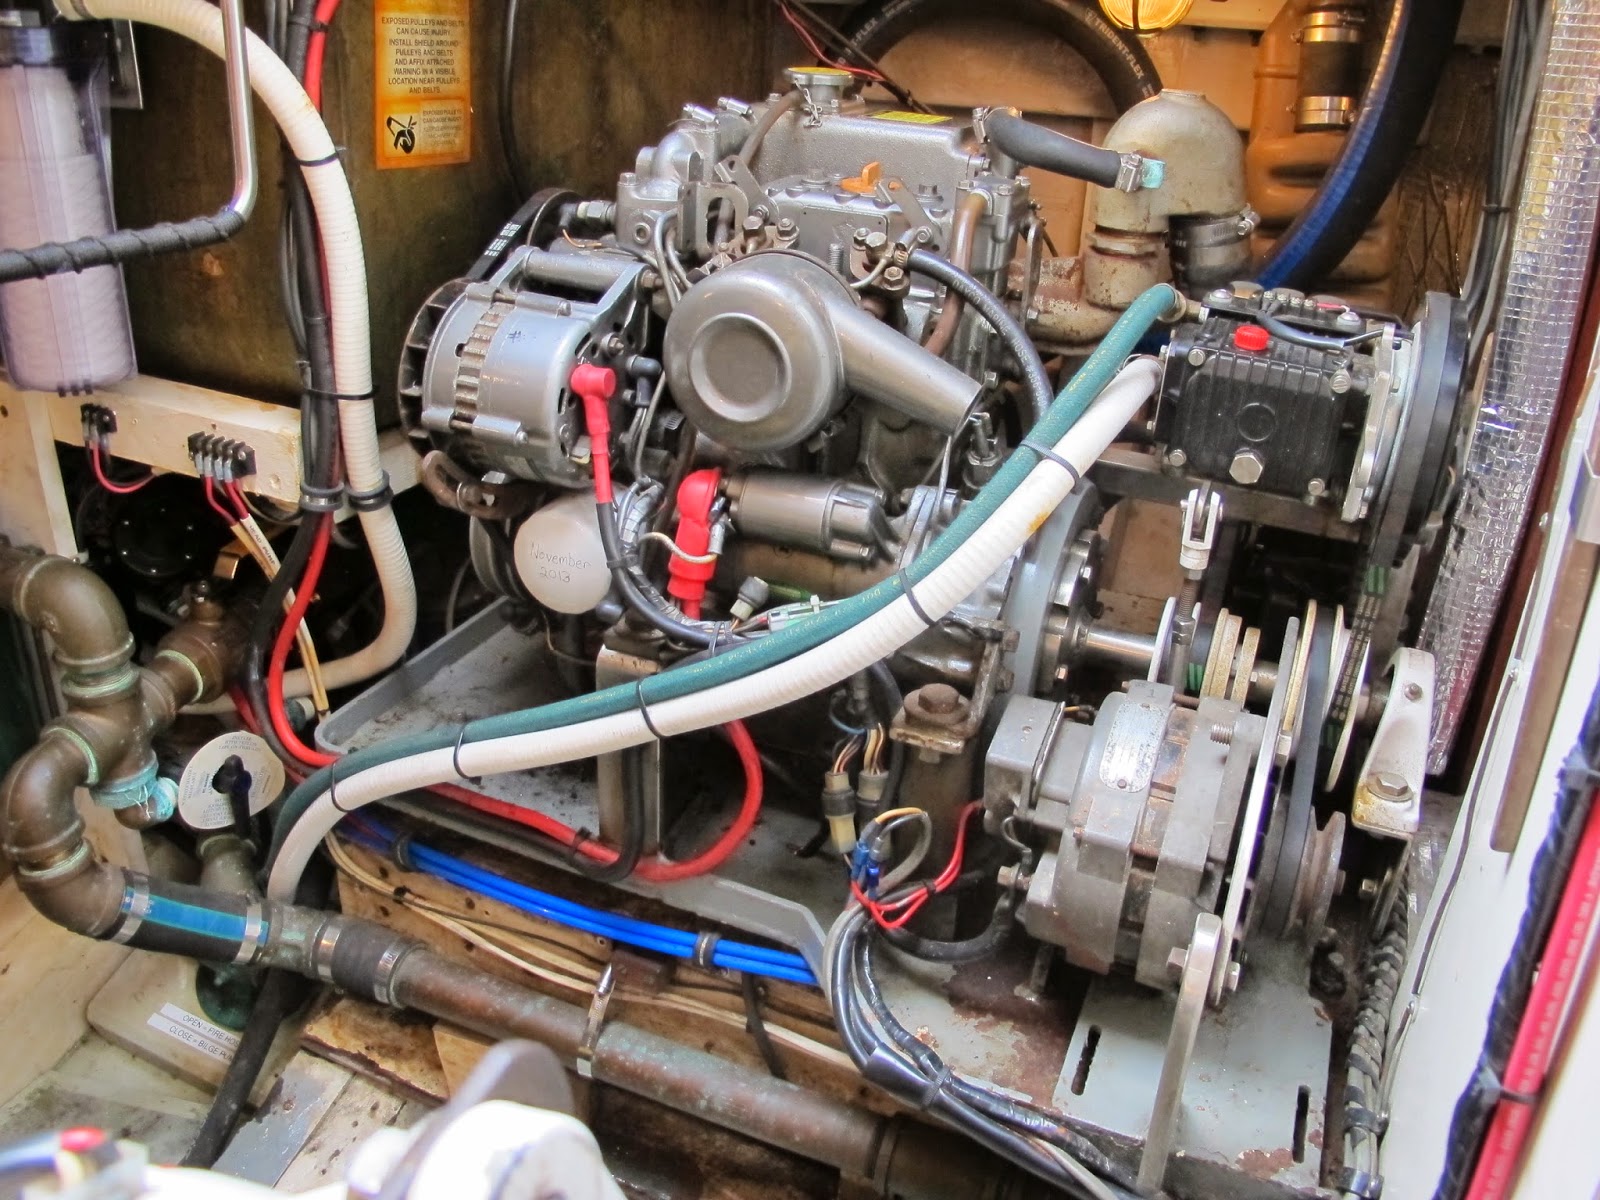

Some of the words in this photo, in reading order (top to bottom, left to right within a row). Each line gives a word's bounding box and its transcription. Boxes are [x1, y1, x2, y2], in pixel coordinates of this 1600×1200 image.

[382, 16, 409, 25] EXPOSED
[410, 18, 435, 26] PULLEYS
[1011, 337, 1031, 362] HOSE
[530, 542, 592, 570] November
[540, 566, 570, 583] 2013
[169, 1025, 193, 1042] CLOSE
[198, 1040, 219, 1055] BILGE
[182, 1014, 203, 1028] OPEN
[207, 1027, 225, 1040] FIRE
[225, 1036, 240, 1048] HOS
